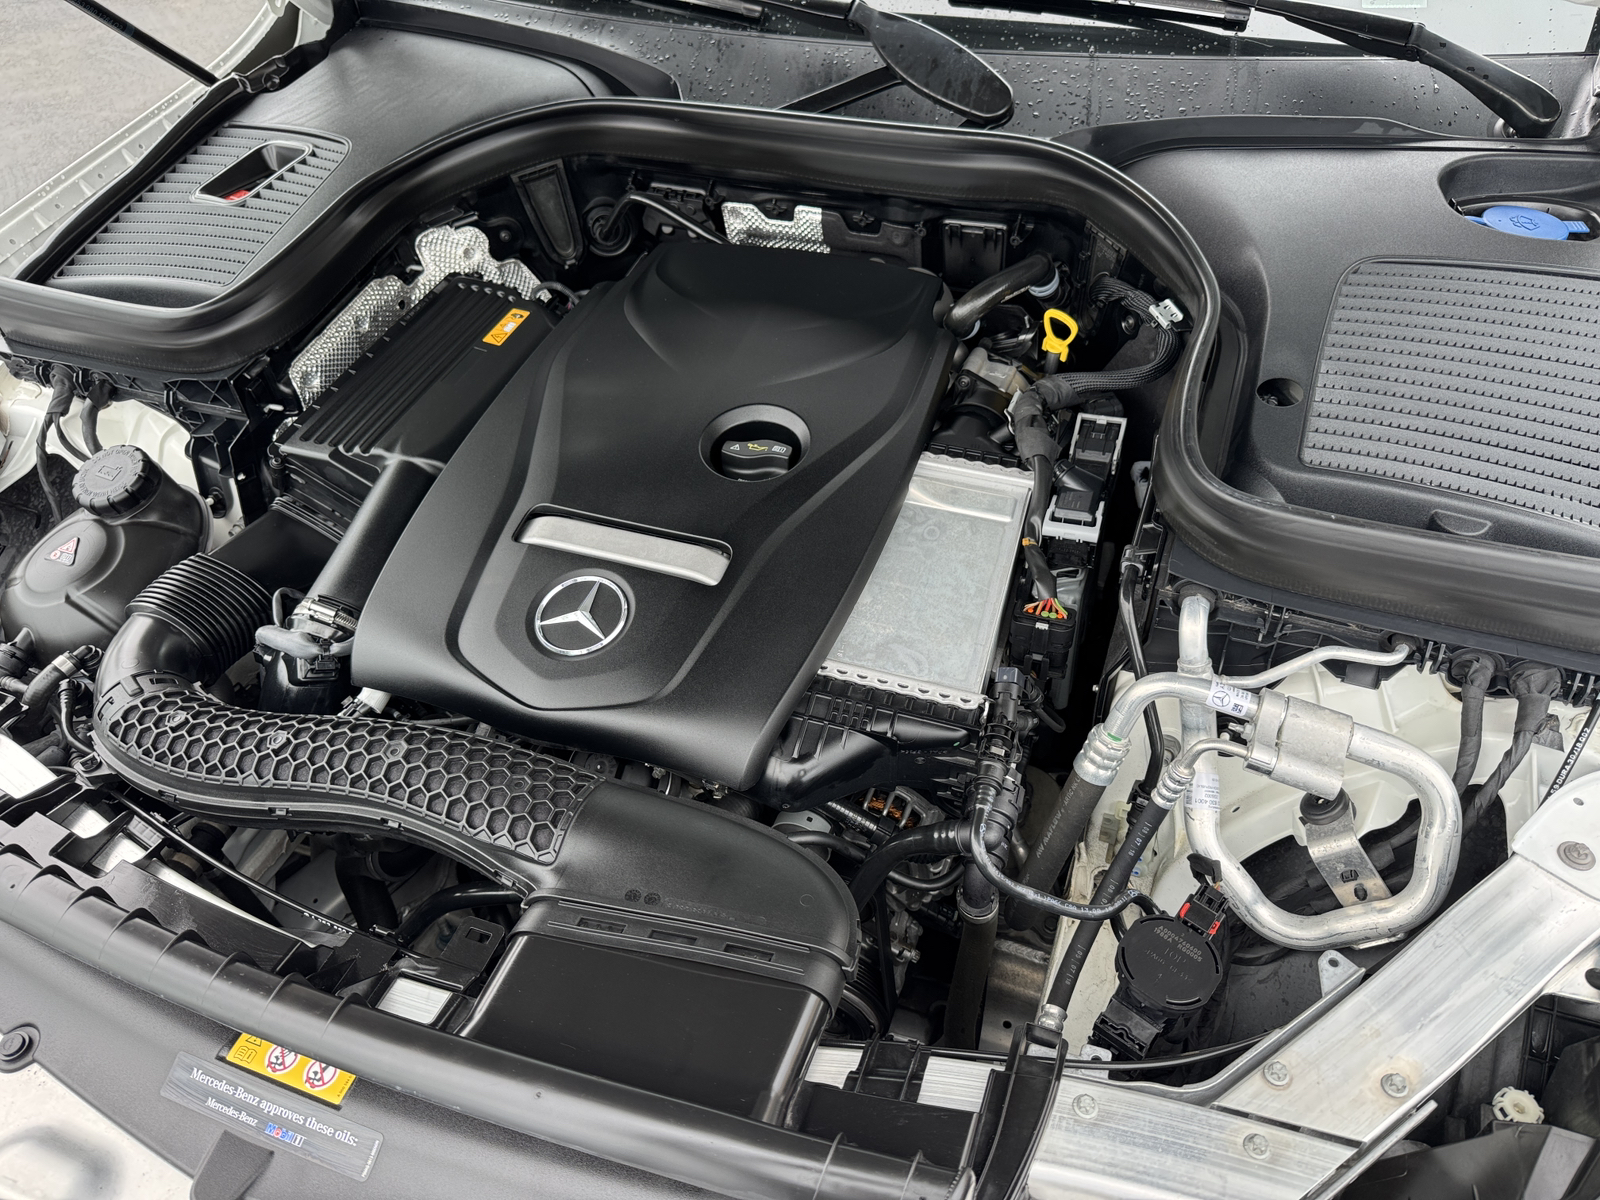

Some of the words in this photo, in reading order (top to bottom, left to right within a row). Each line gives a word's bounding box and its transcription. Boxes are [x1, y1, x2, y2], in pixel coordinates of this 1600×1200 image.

[190, 1067, 259, 1106] Mercedes-Benz
[260, 1100, 305, 1125] approves
[306, 1116, 335, 1137] these
[335, 1129, 360, 1147] oils:
[205, 1096, 259, 1127] Mercedes-Benz
[265, 1122, 294, 1144] Mobil
